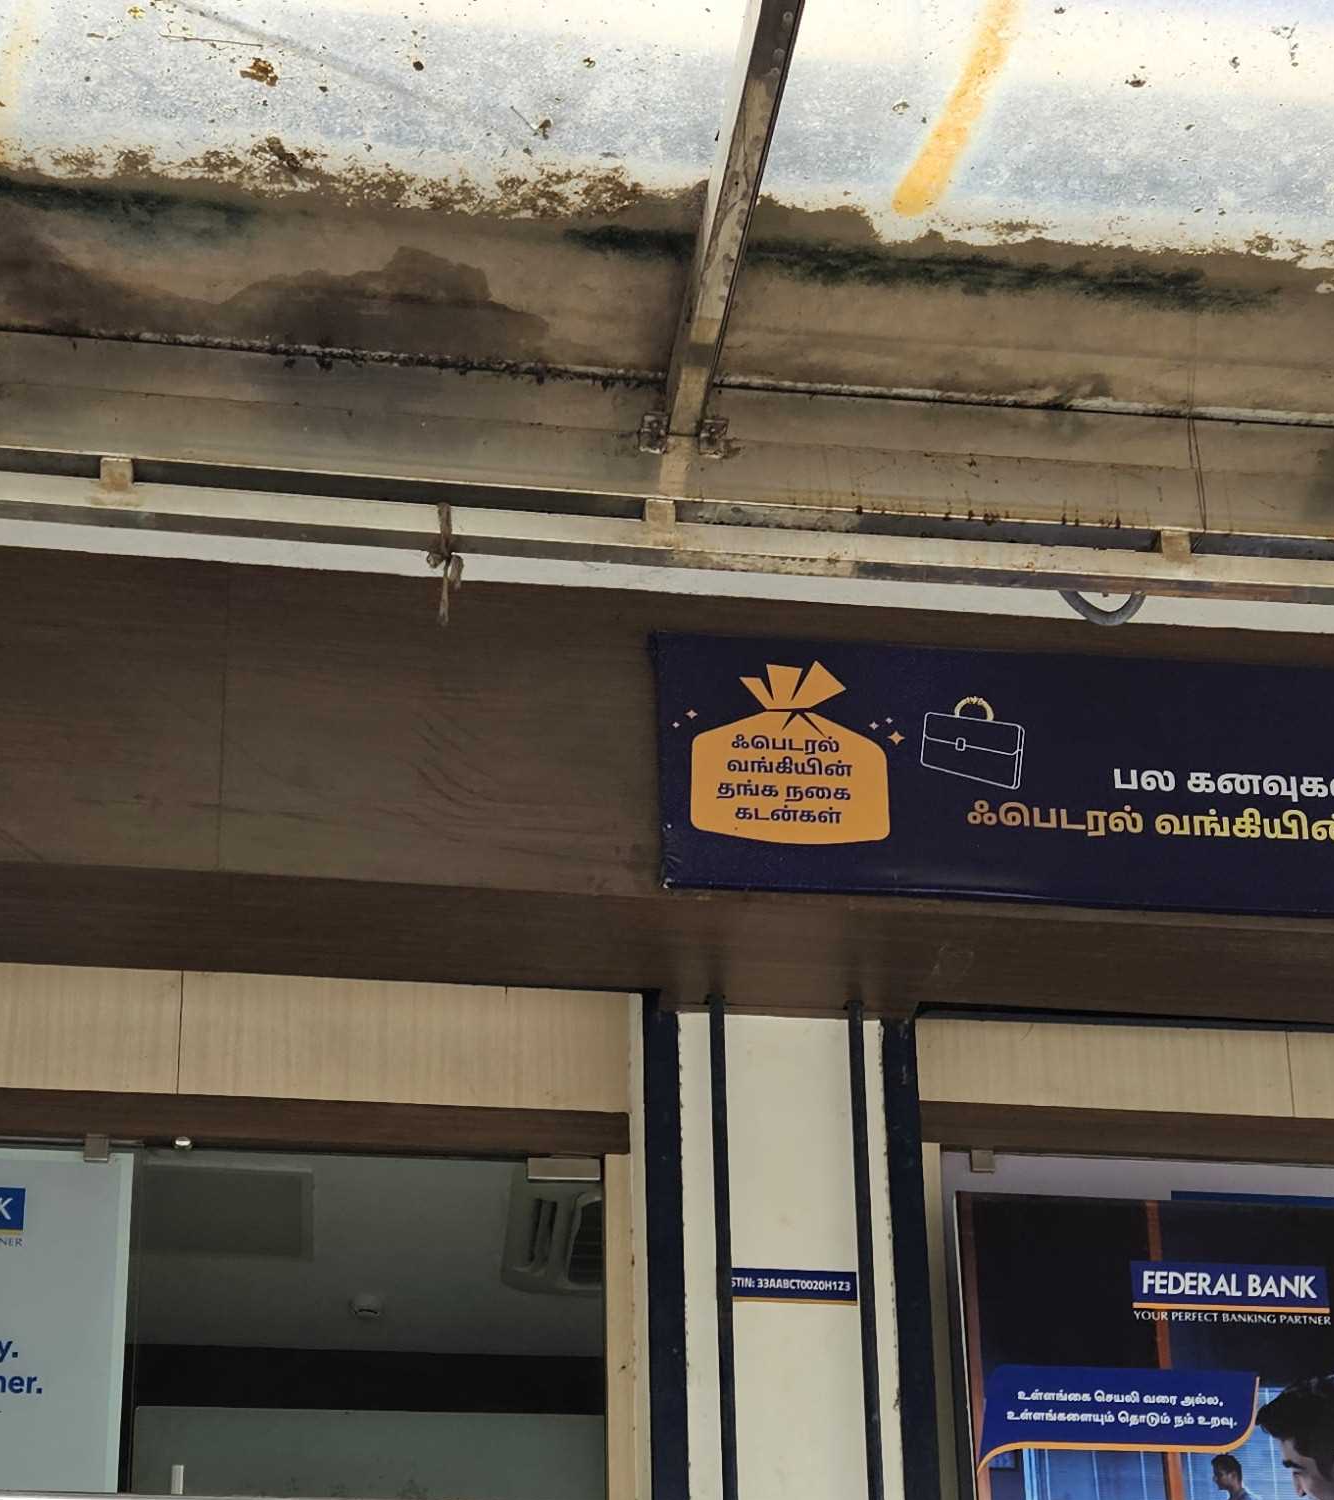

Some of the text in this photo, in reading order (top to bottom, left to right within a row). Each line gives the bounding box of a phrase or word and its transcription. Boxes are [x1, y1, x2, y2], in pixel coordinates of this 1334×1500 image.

[731, 734, 840, 755] ஃபெடரல்
[727, 756, 852, 777] வங்கியின்
[716, 779, 851, 802] தங்க நகை
[1114, 767, 1175, 793] பல
[735, 805, 842, 824] கடன்கள்
[967, 800, 1143, 837] ஃபெடரல்
[1141, 1270, 1318, 1299] FEDERAL BANK
[1133, 1310, 1331, 1326] YOUR PERFECT BANKING PARTNER
